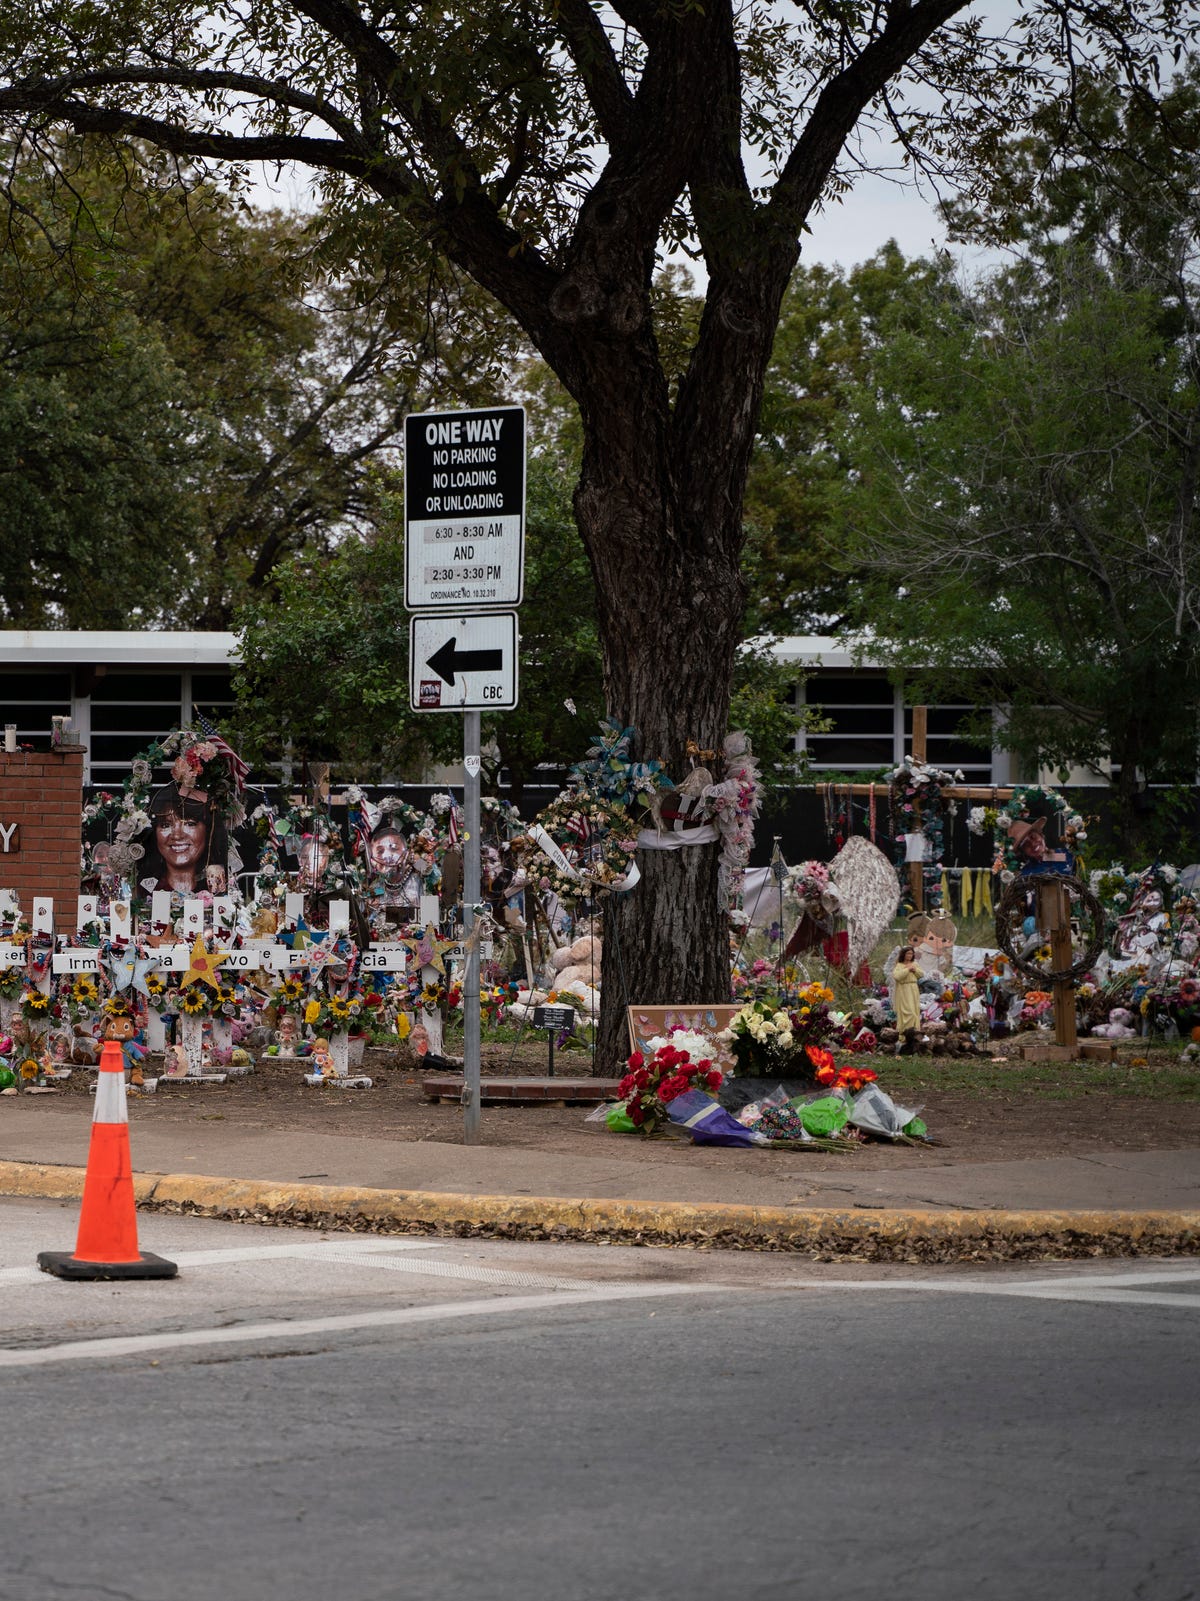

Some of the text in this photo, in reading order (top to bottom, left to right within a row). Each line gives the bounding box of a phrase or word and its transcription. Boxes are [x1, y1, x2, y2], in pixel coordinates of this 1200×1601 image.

[425, 418, 504, 446] ONE WAY
[433, 447, 497, 466] NO PARKING
[433, 470, 497, 489] NO LOADING
[426, 493, 504, 512] OR UNLOADING
[435, 527, 453, 540] 6:30
[463, 525, 484, 538] 8:30
[487, 523, 503, 538] AM
[453, 546, 475, 561] AND
[432, 569, 454, 581] 2:30
[463, 567, 484, 580] 3:30
[486, 565, 501, 580] PM
[430, 590, 462, 600] ORDINANCE
[482, 685, 503, 699] CBC
